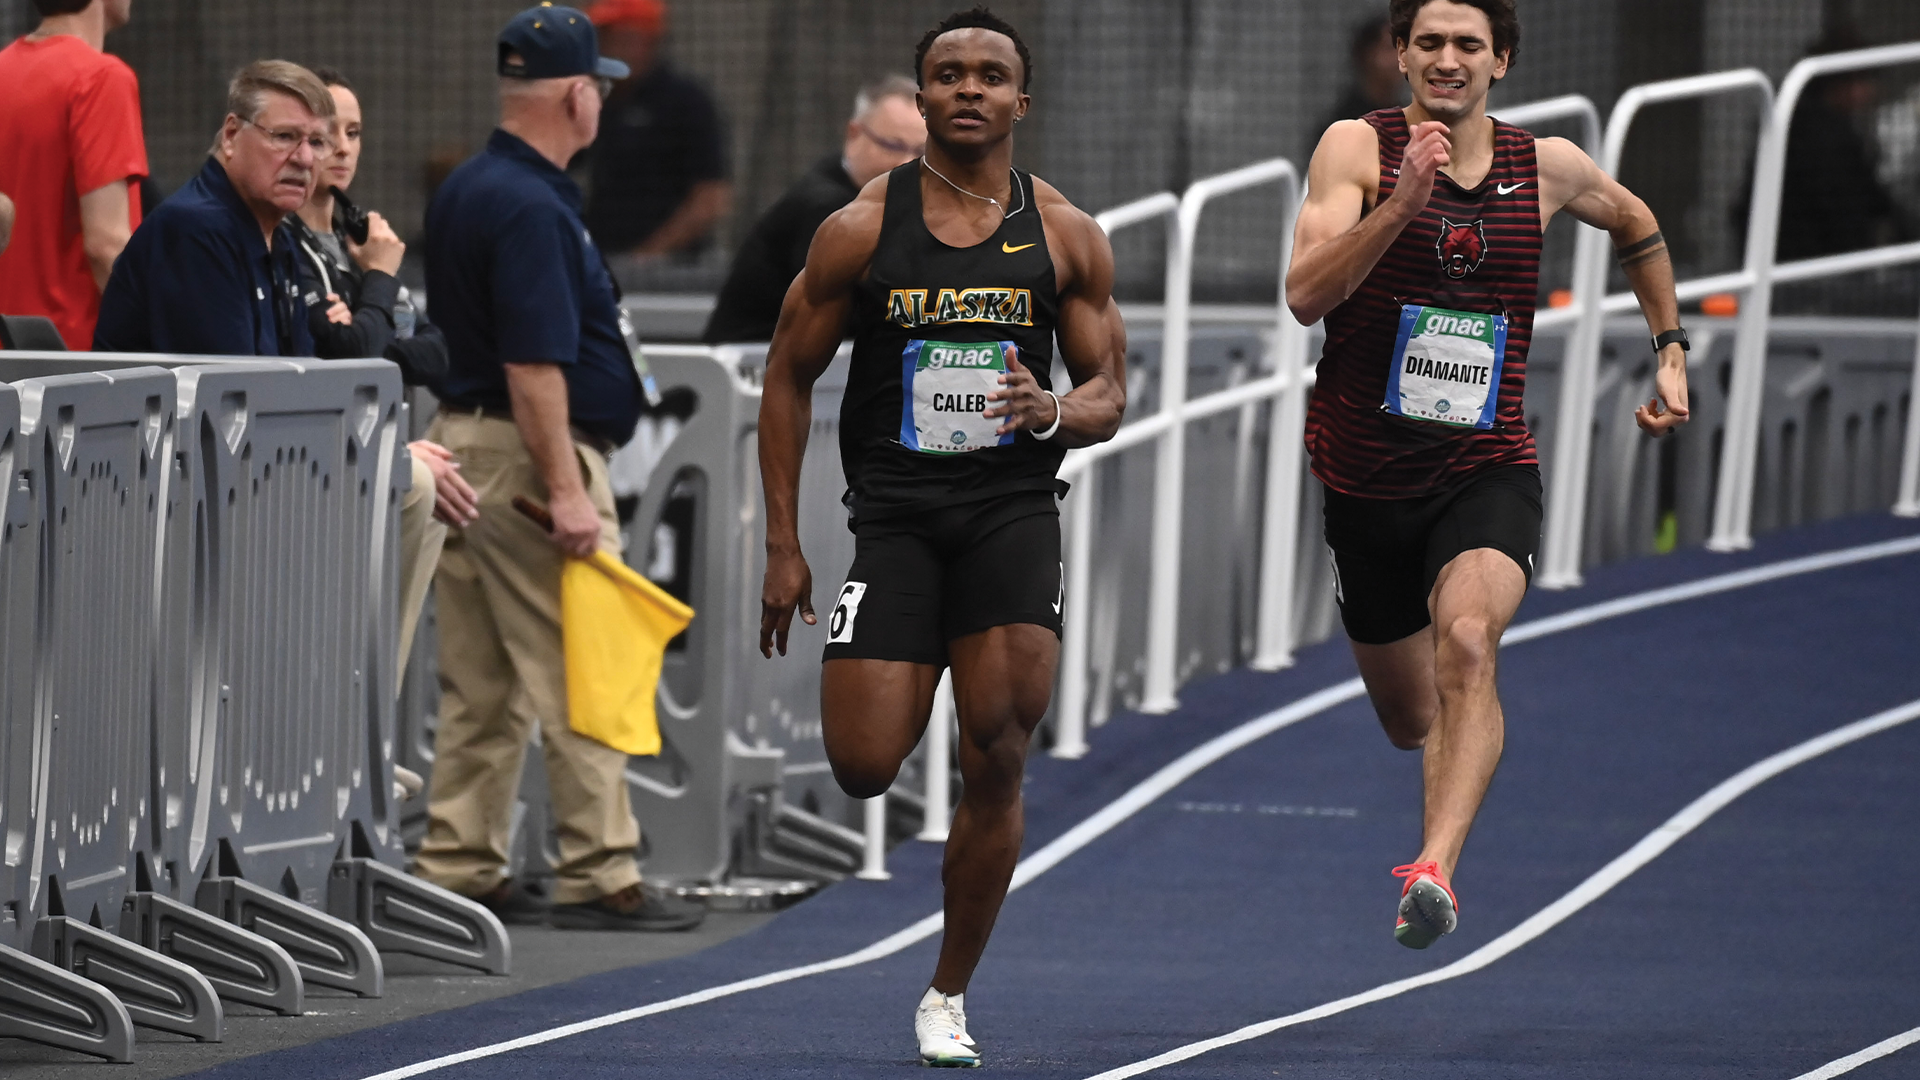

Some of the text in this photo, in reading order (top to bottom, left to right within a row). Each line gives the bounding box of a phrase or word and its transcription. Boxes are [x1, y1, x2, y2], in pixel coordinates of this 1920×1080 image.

[886, 288, 1033, 328] ALASKA
[1424, 314, 1486, 337] gnac
[928, 347, 993, 370] gnac
[1405, 356, 1489, 385] DIAMANTE
[933, 393, 986, 412] CALEB
[830, 584, 855, 640] 6
